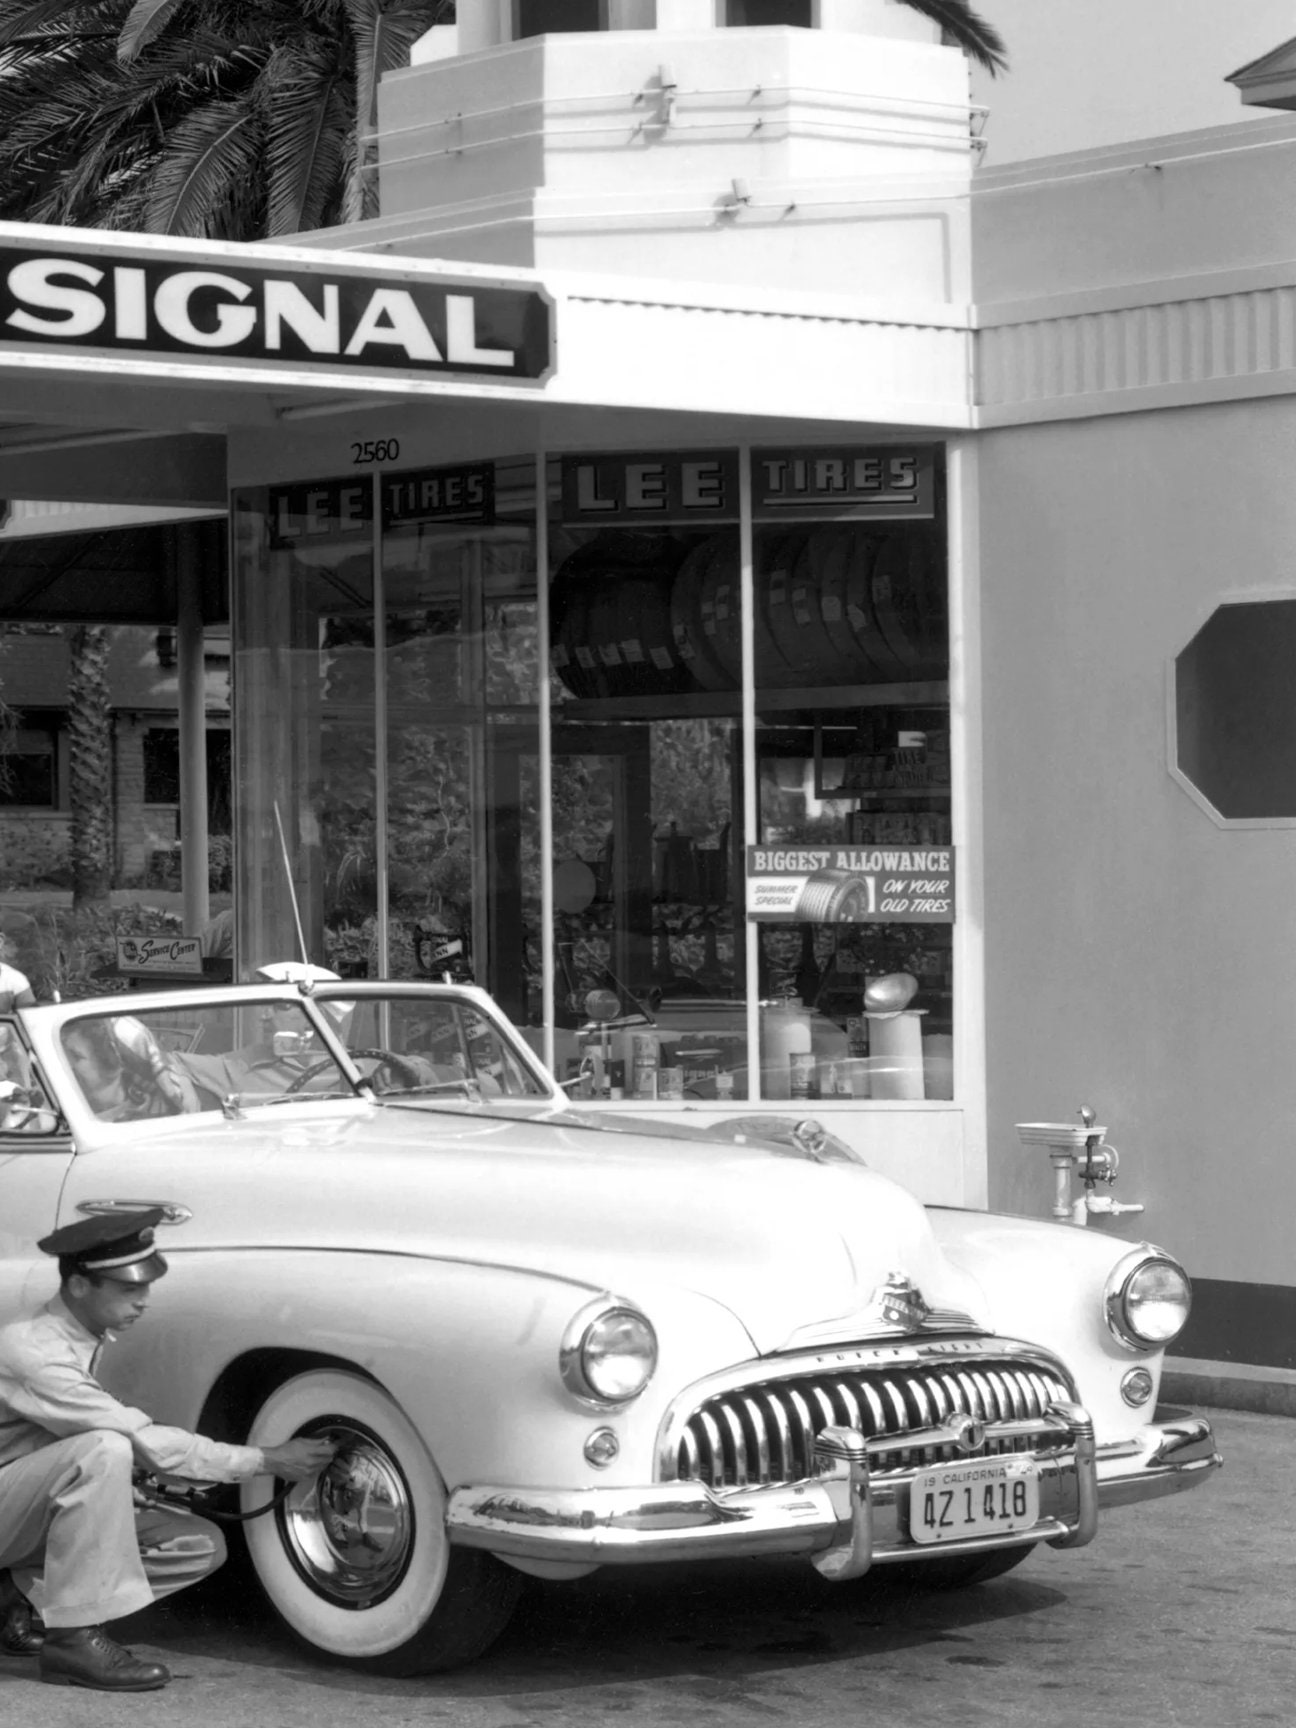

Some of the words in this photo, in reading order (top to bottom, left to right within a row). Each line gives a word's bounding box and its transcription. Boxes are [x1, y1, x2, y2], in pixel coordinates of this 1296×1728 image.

[5, 258, 514, 367] SIGNAL
[350, 438, 400, 465] 2560
[577, 461, 725, 513] LEE
[762, 457, 919, 493] TIRES
[278, 487, 364, 538] LEE
[389, 474, 484, 515] TIRES
[754, 851, 830, 871] BIGGEST
[836, 851, 950, 872] ALLOWANCE
[754, 885, 798, 894] SUMMER
[882, 879, 906, 893] ON
[908, 879, 950, 893] YOUR
[754, 896, 794, 906] SPECIAL
[880, 898, 909, 912] OLD
[910, 898, 951, 913] TIRES
[924, 1477, 936, 1487] 19
[943, 1466, 1007, 1485] CALIFORNIA
